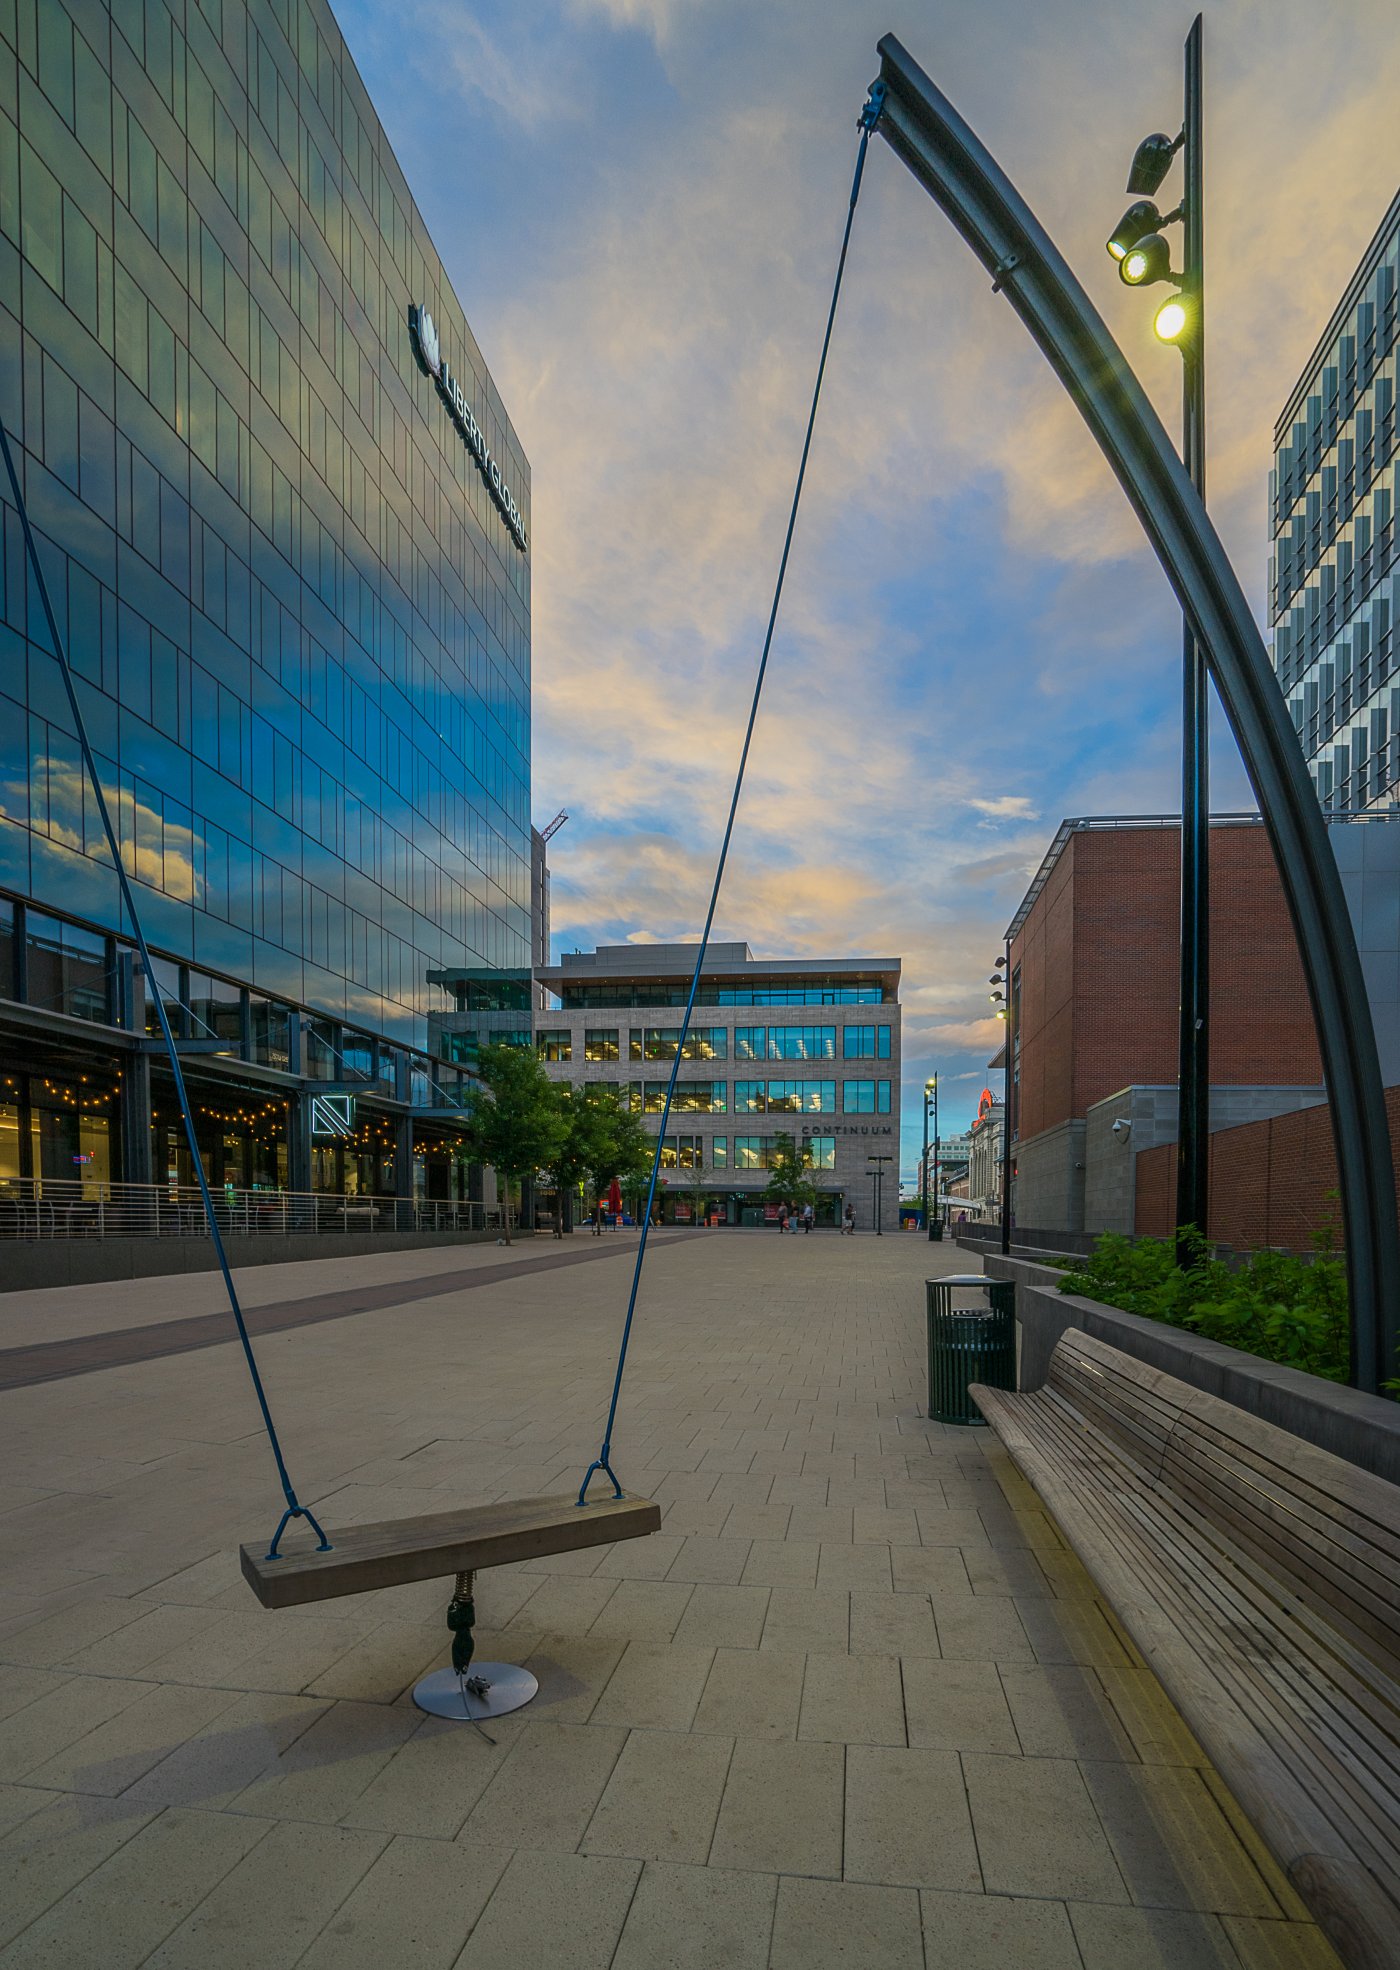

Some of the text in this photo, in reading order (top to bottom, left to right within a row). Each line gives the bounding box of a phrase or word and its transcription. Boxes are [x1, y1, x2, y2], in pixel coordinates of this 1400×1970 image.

[442, 362, 528, 548] LIBERTY GLOBAL
[801, 1126, 892, 1135] CONTINUUM
